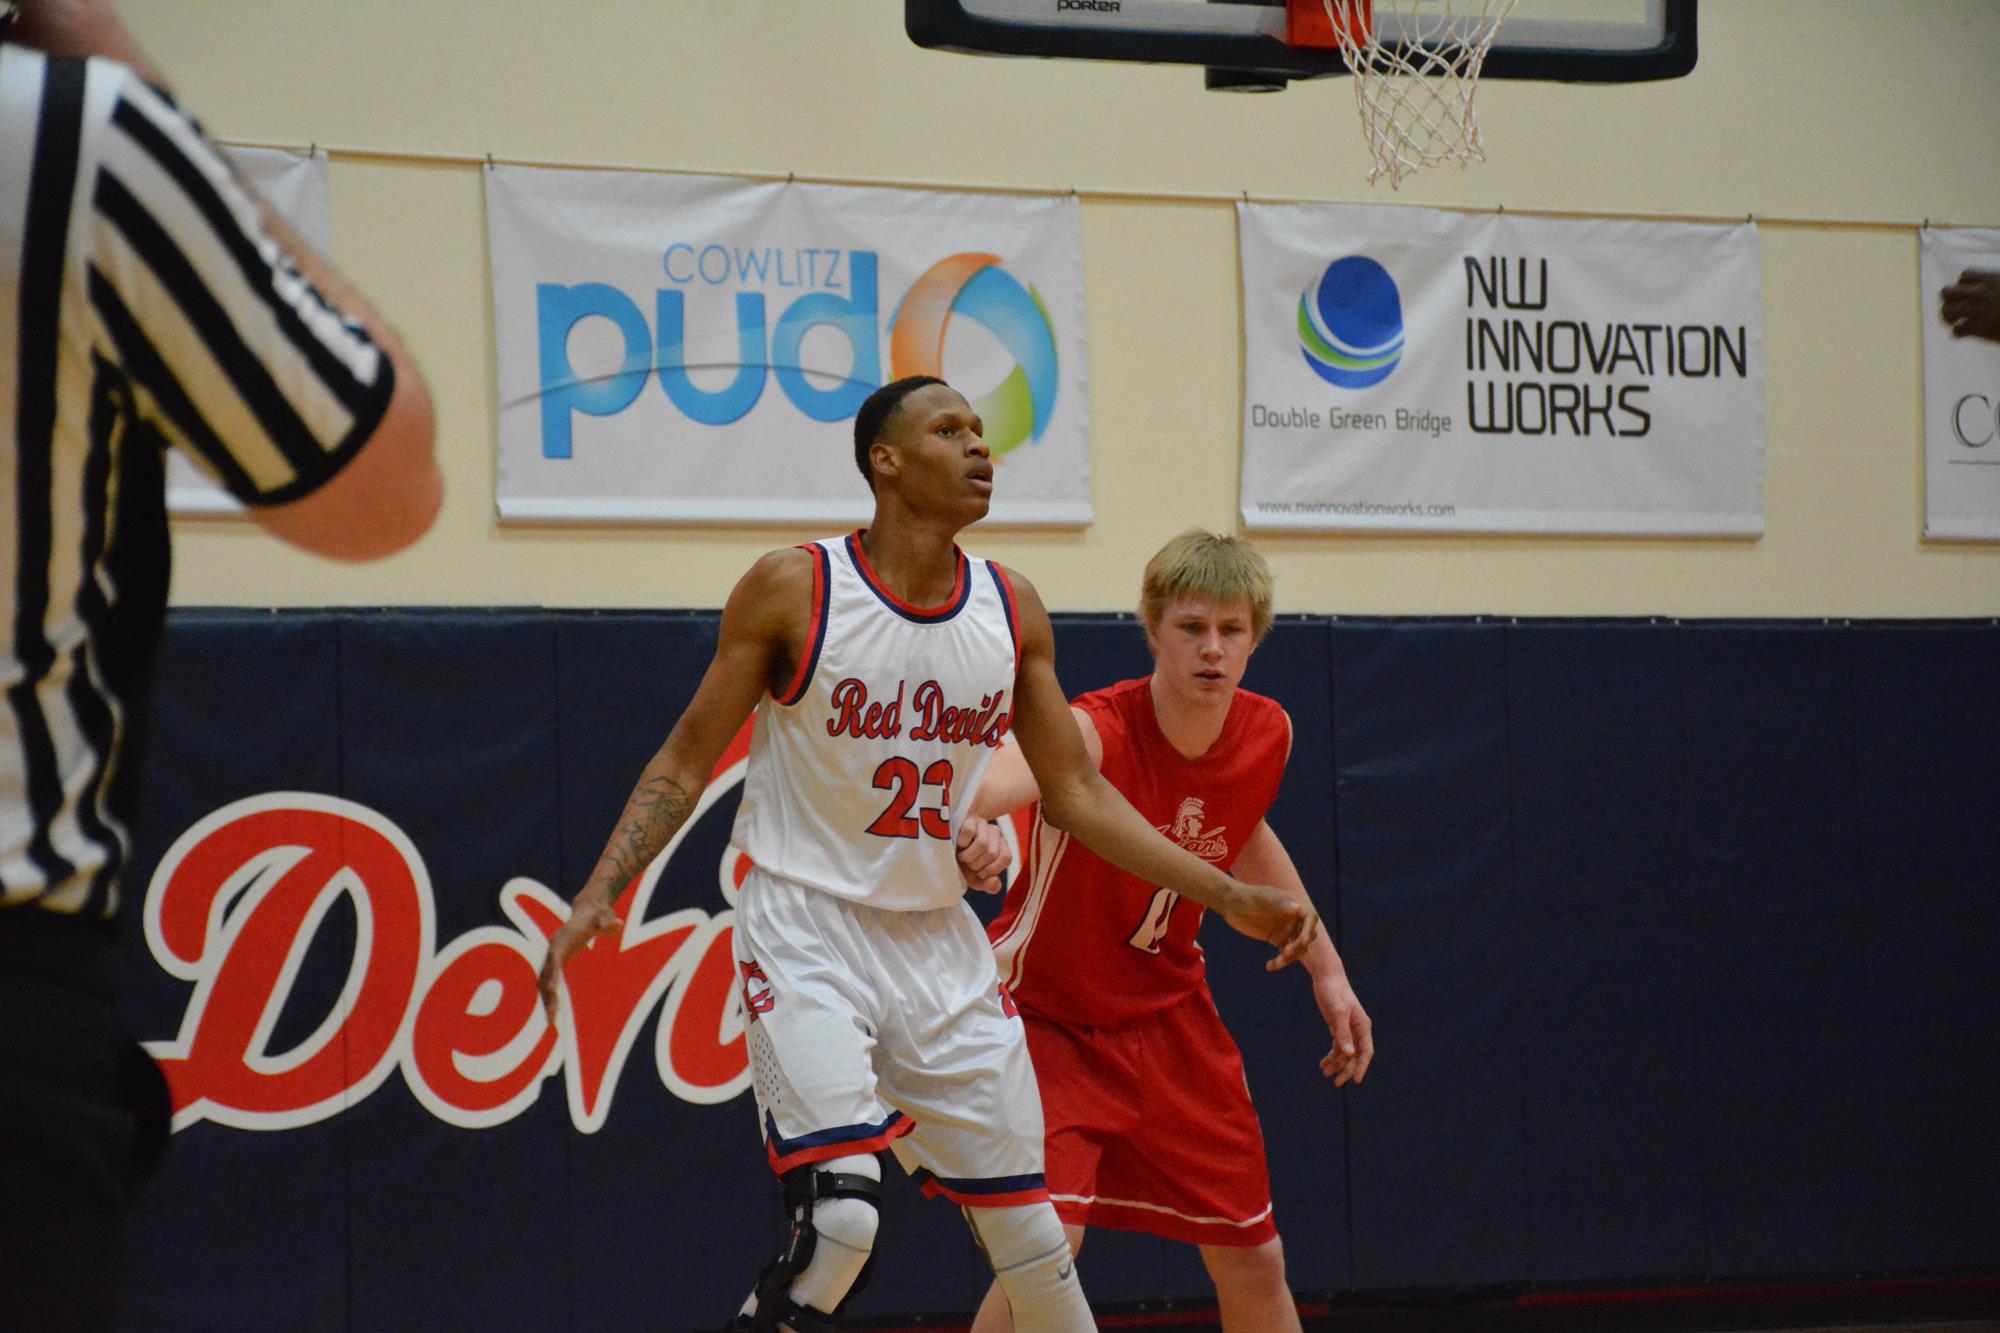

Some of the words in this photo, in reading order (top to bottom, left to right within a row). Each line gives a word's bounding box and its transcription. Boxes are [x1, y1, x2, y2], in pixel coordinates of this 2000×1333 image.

[663, 243, 842, 288] COWLITZ
[1463, 256, 1548, 311] NW
[536, 251, 882, 460] pud
[1466, 317, 1747, 378] INNOVATION
[1252, 405, 1320, 429] Double
[1329, 407, 1387, 430] Green
[1396, 408, 1453, 438] Bridge
[1467, 381, 1652, 438] WORKS
[1256, 500, 1456, 517] www.nwinnovationworks.com
[826, 678, 904, 740] Red
[910, 680, 1008, 748] Devils
[864, 756, 954, 840] 23
